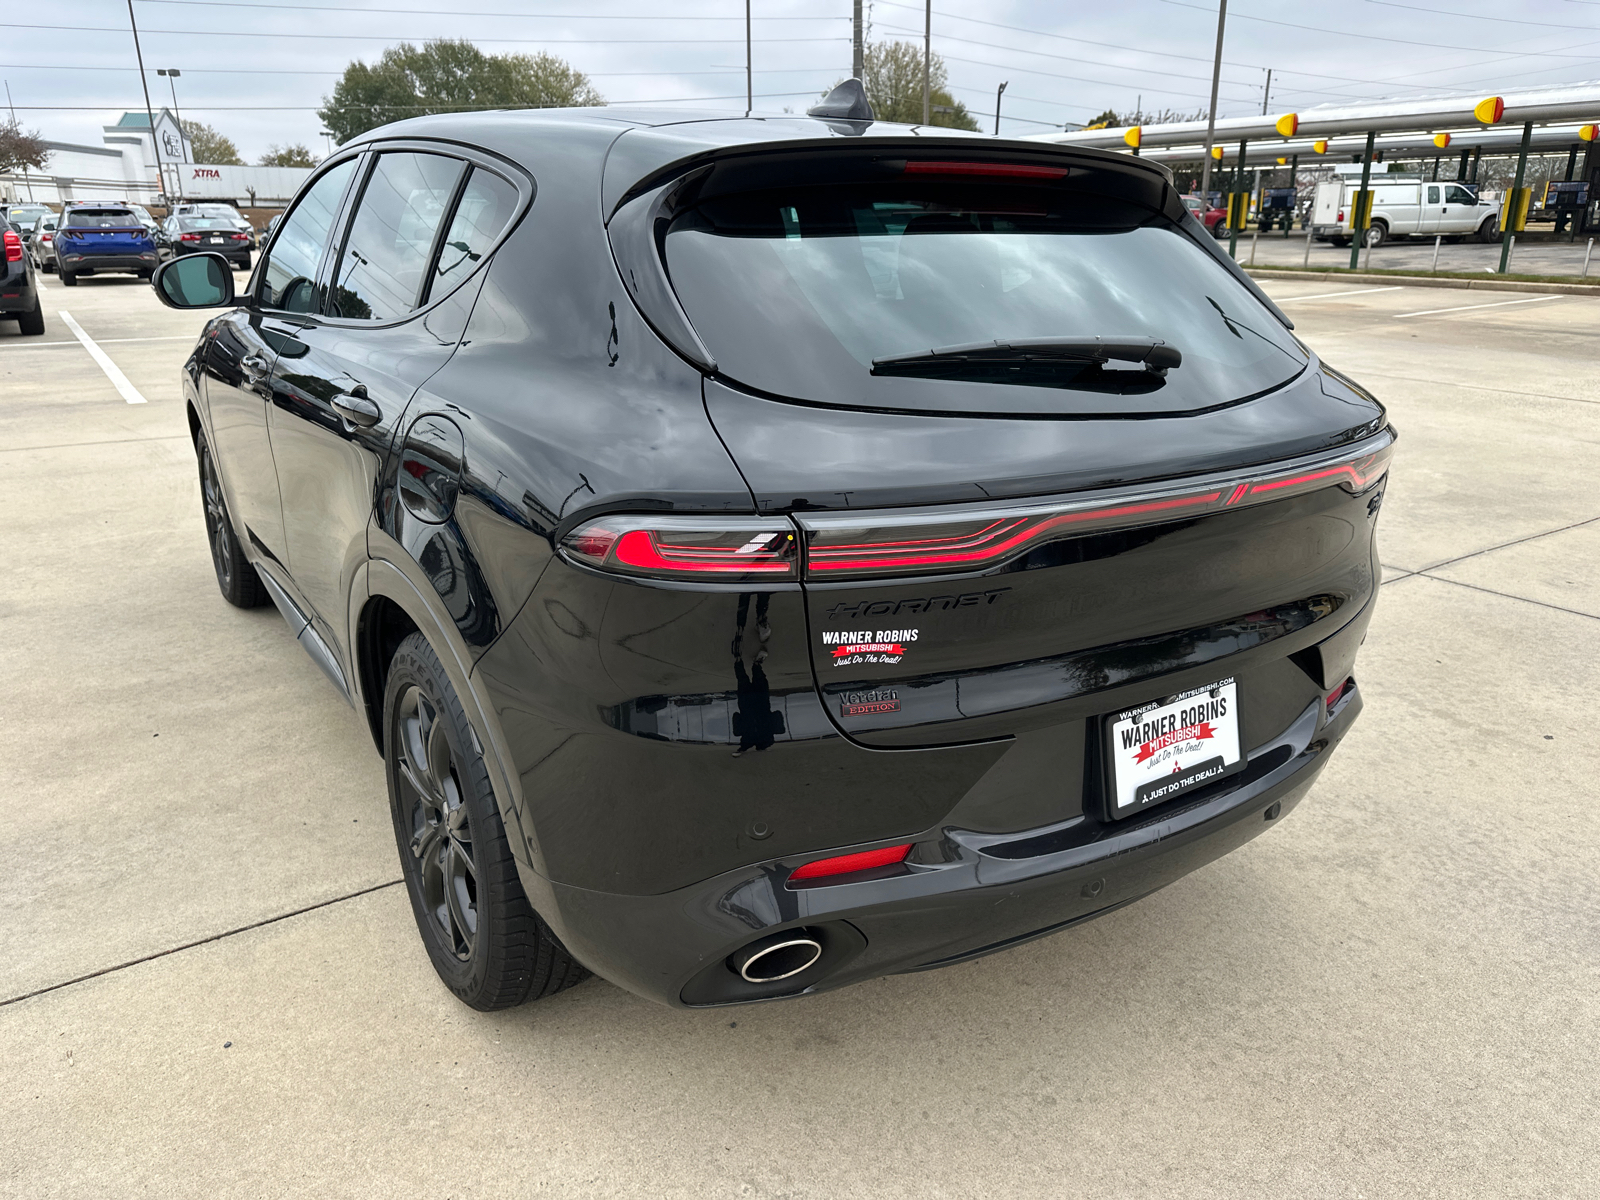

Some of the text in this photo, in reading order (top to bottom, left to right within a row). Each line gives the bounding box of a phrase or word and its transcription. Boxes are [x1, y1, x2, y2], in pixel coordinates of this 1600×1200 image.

[192, 169, 220, 179] XTRA
[825, 586, 1012, 620] HORNET
[822, 629, 919, 645] WARNER ROBINS
[846, 644, 893, 653] MITSUBISHI
[833, 654, 902, 667] Just Do The Deal!
[839, 689, 899, 705] Veteran
[849, 703, 895, 714] EDITION
[1121, 697, 1227, 750] WARNER ROBINS
[1149, 725, 1201, 752] MITSUBISHI
[1147, 741, 1204, 770] Just Do The Deal!
[1149, 767, 1216, 800] JUST DO THE DEAL!
